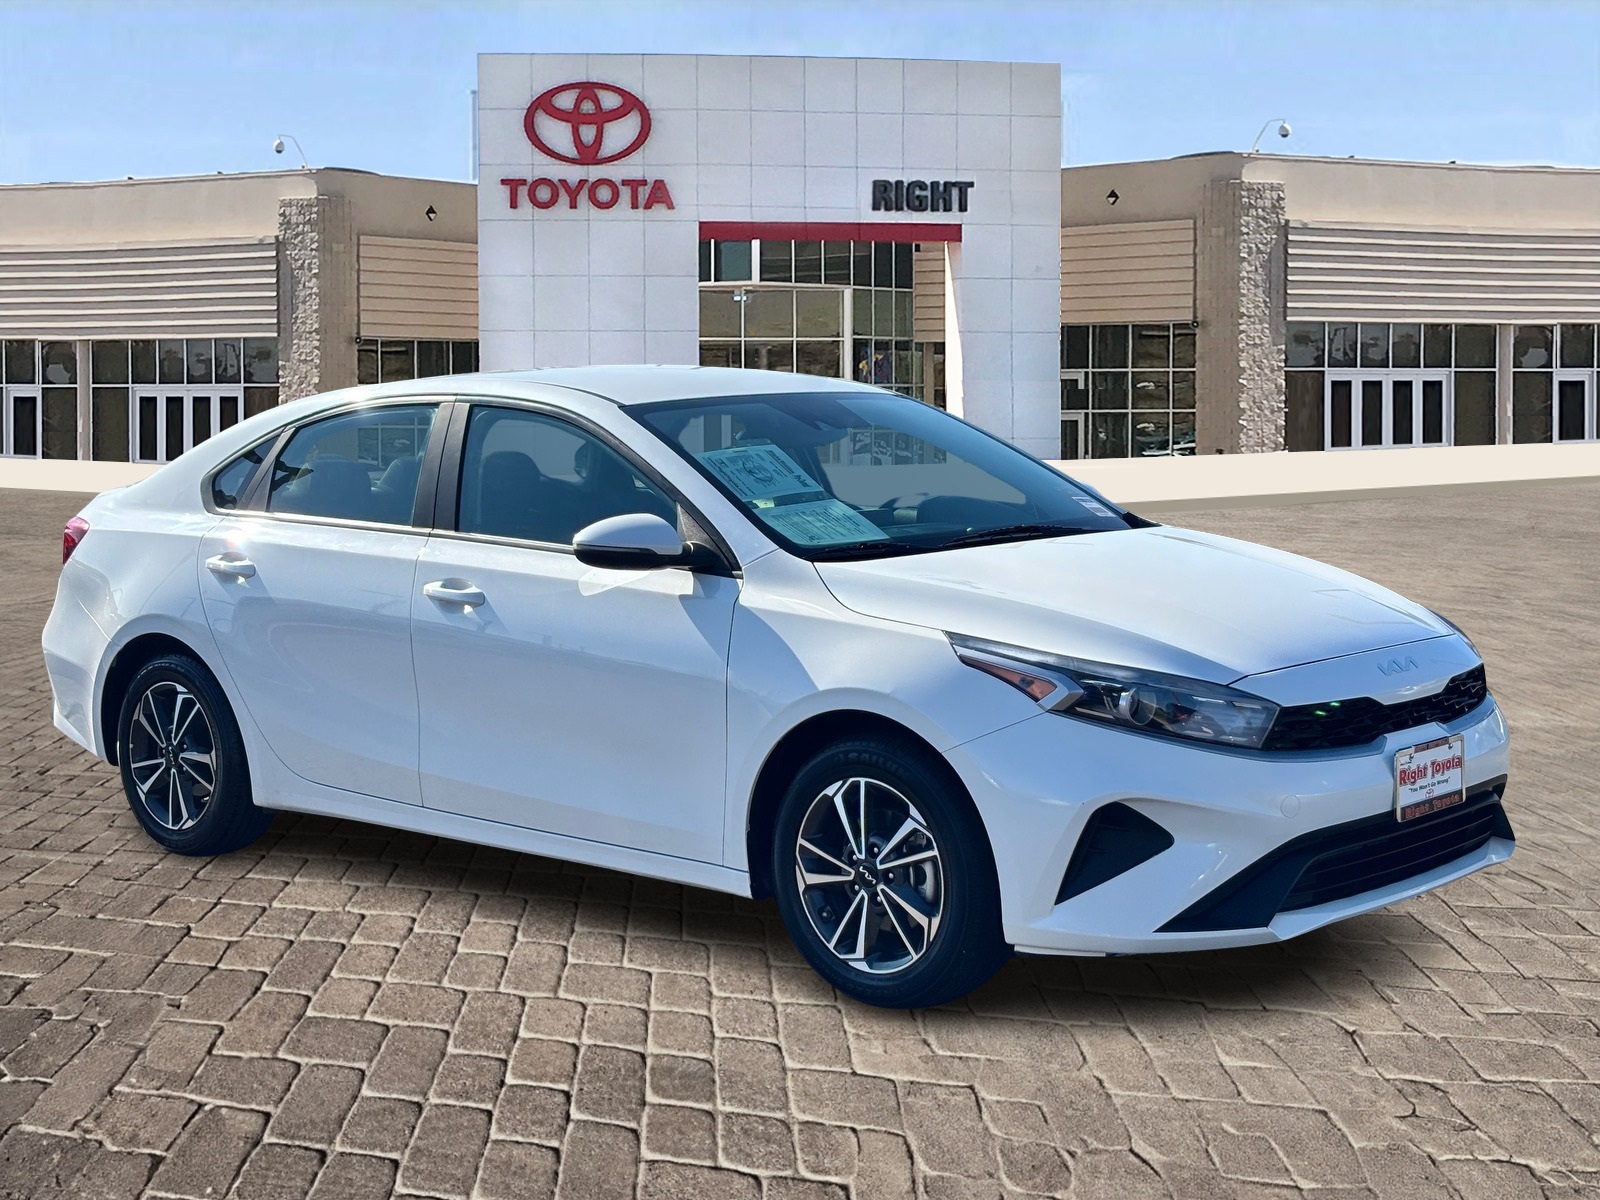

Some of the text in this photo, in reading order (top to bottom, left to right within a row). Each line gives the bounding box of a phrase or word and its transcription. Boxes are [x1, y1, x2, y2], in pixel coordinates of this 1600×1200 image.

[500, 178, 675, 210] TOYOTA
[871, 179, 975, 213] RIGHT
[1399, 754, 1463, 786] Right Toyota
[1405, 793, 1460, 818] Right Toyota
